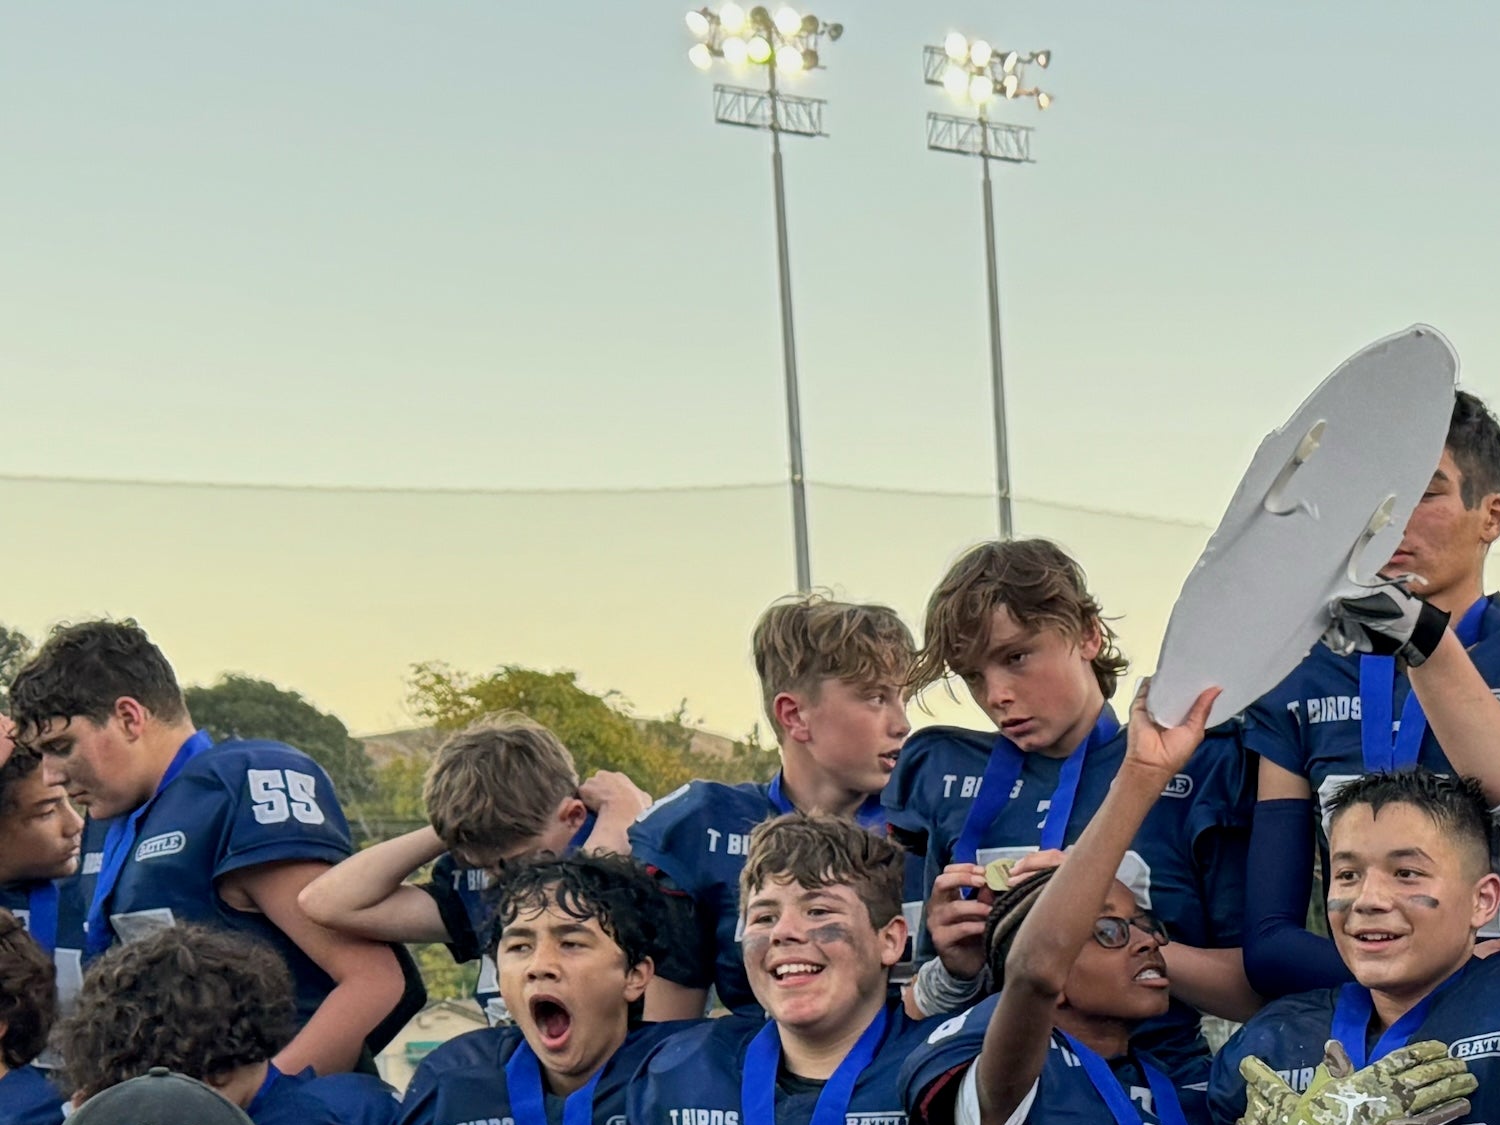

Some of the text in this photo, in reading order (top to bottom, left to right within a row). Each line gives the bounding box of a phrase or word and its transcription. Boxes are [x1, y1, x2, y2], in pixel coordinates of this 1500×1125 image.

[1307, 696, 1361, 724] BIRDS
[247, 769, 325, 825] 55
[943, 775, 957, 798] T
[707, 828, 721, 853] T
